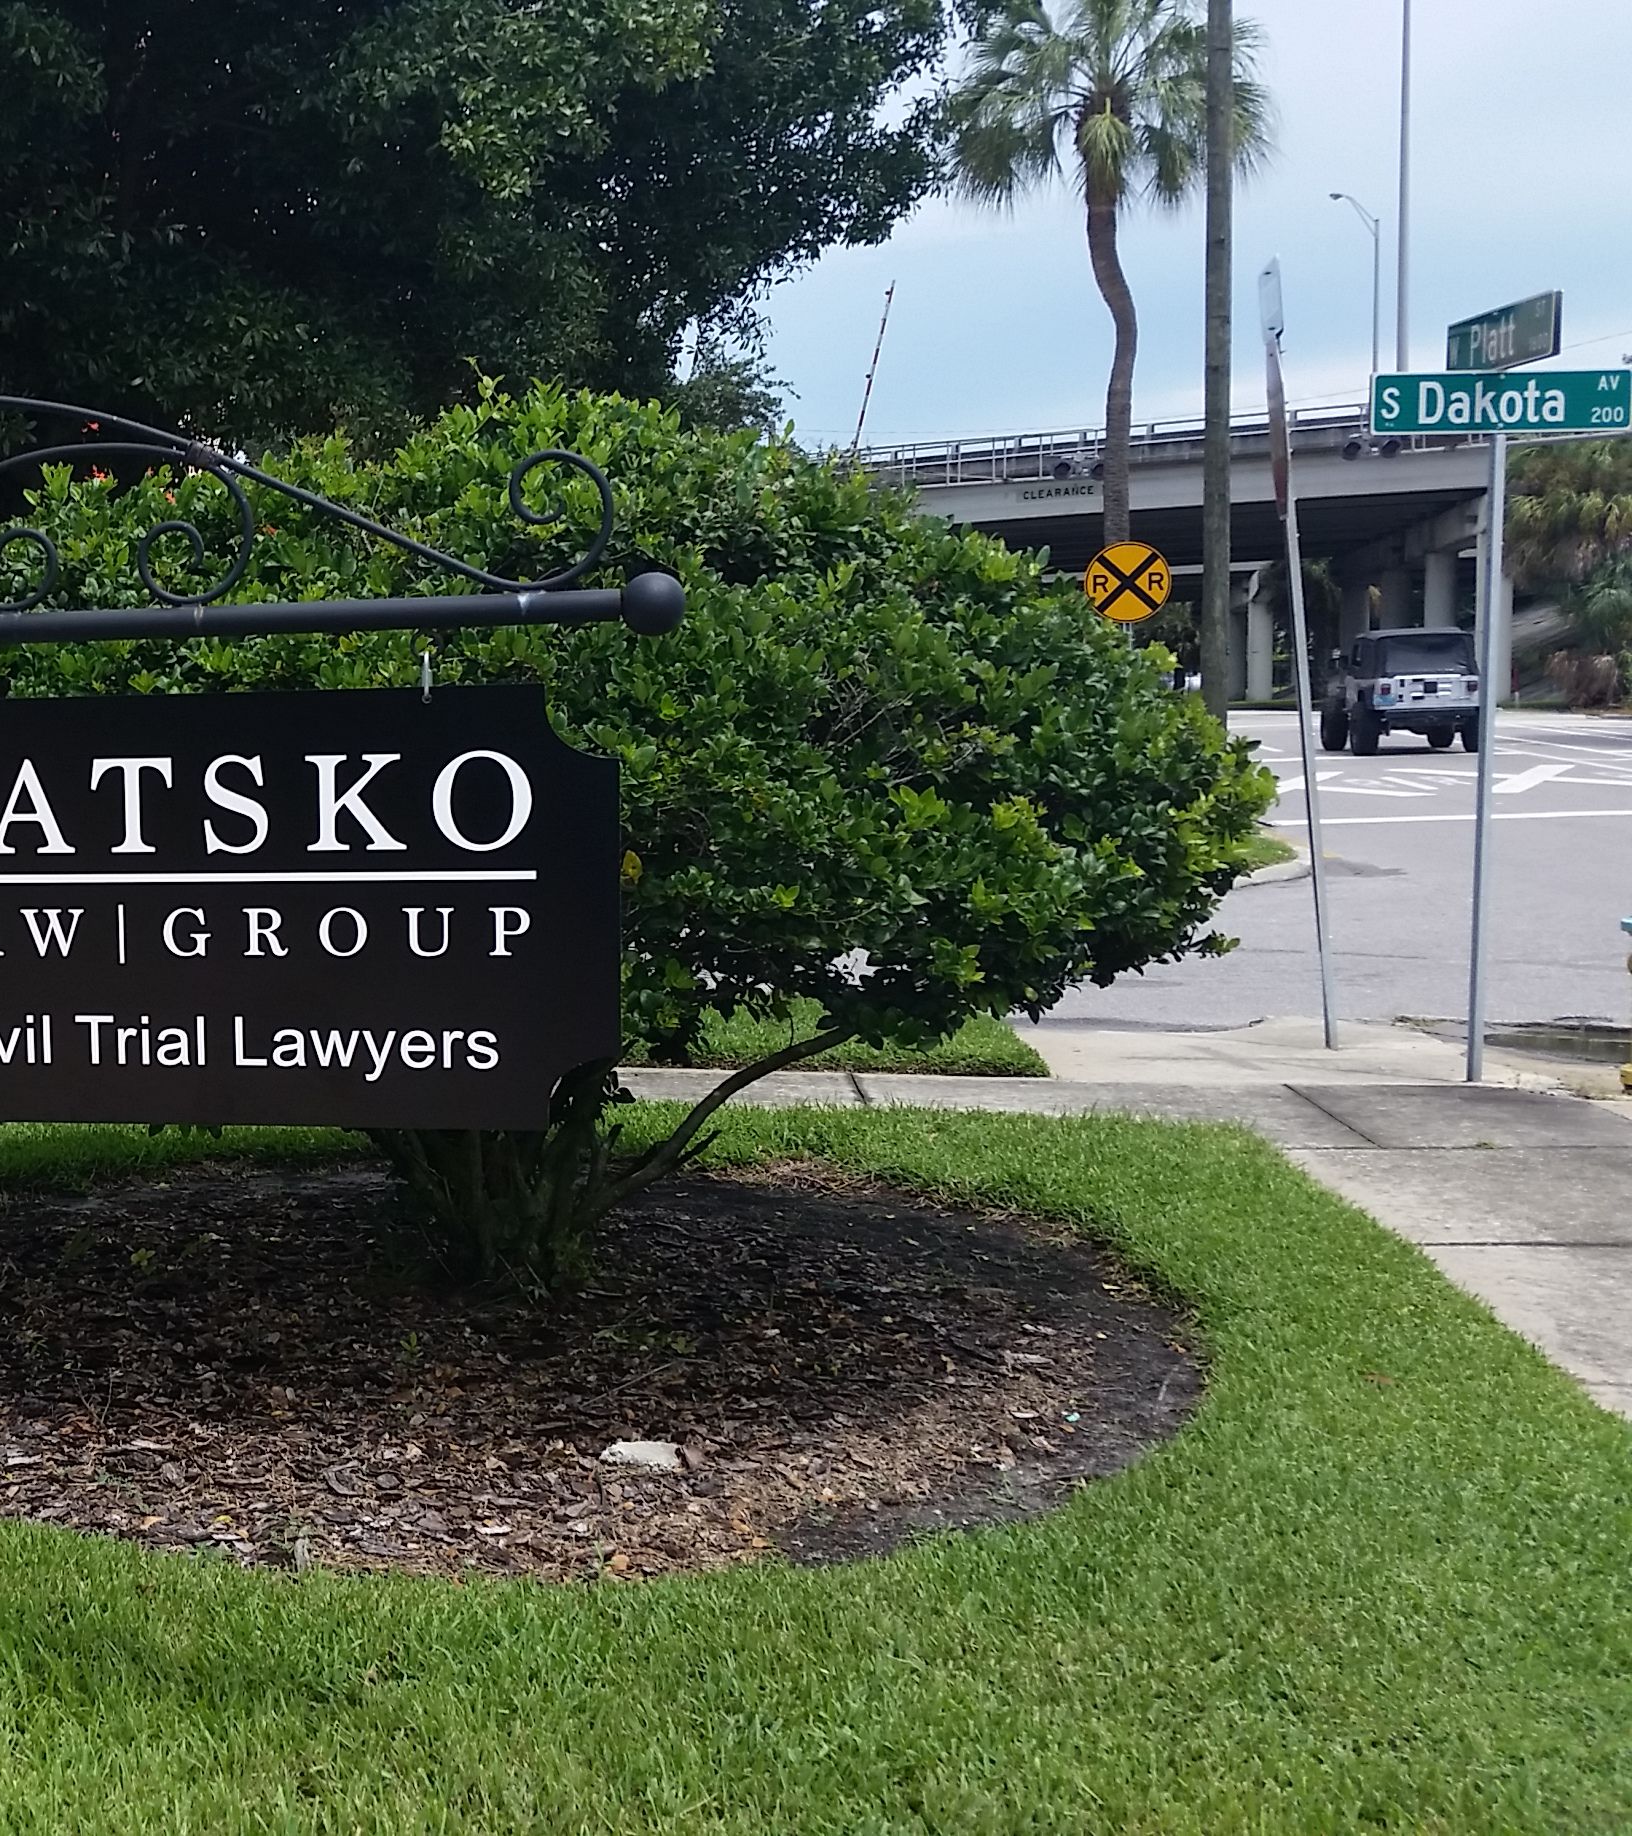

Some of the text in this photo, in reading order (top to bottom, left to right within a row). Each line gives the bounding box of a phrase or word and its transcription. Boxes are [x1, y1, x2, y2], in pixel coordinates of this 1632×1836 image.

[1470, 312, 1515, 368] Platt
[1597, 375, 1620, 391] AV
[1380, 379, 1566, 425] S Dakota
[1590, 406, 1624, 424] 200
[1023, 485, 1095, 500] CLEARANCE
[1092, 572, 1164, 594] R R
[161, 904, 533, 959] GROUP
[74, 1013, 207, 1067] Trial
[234, 1014, 500, 1082] Lawyers
